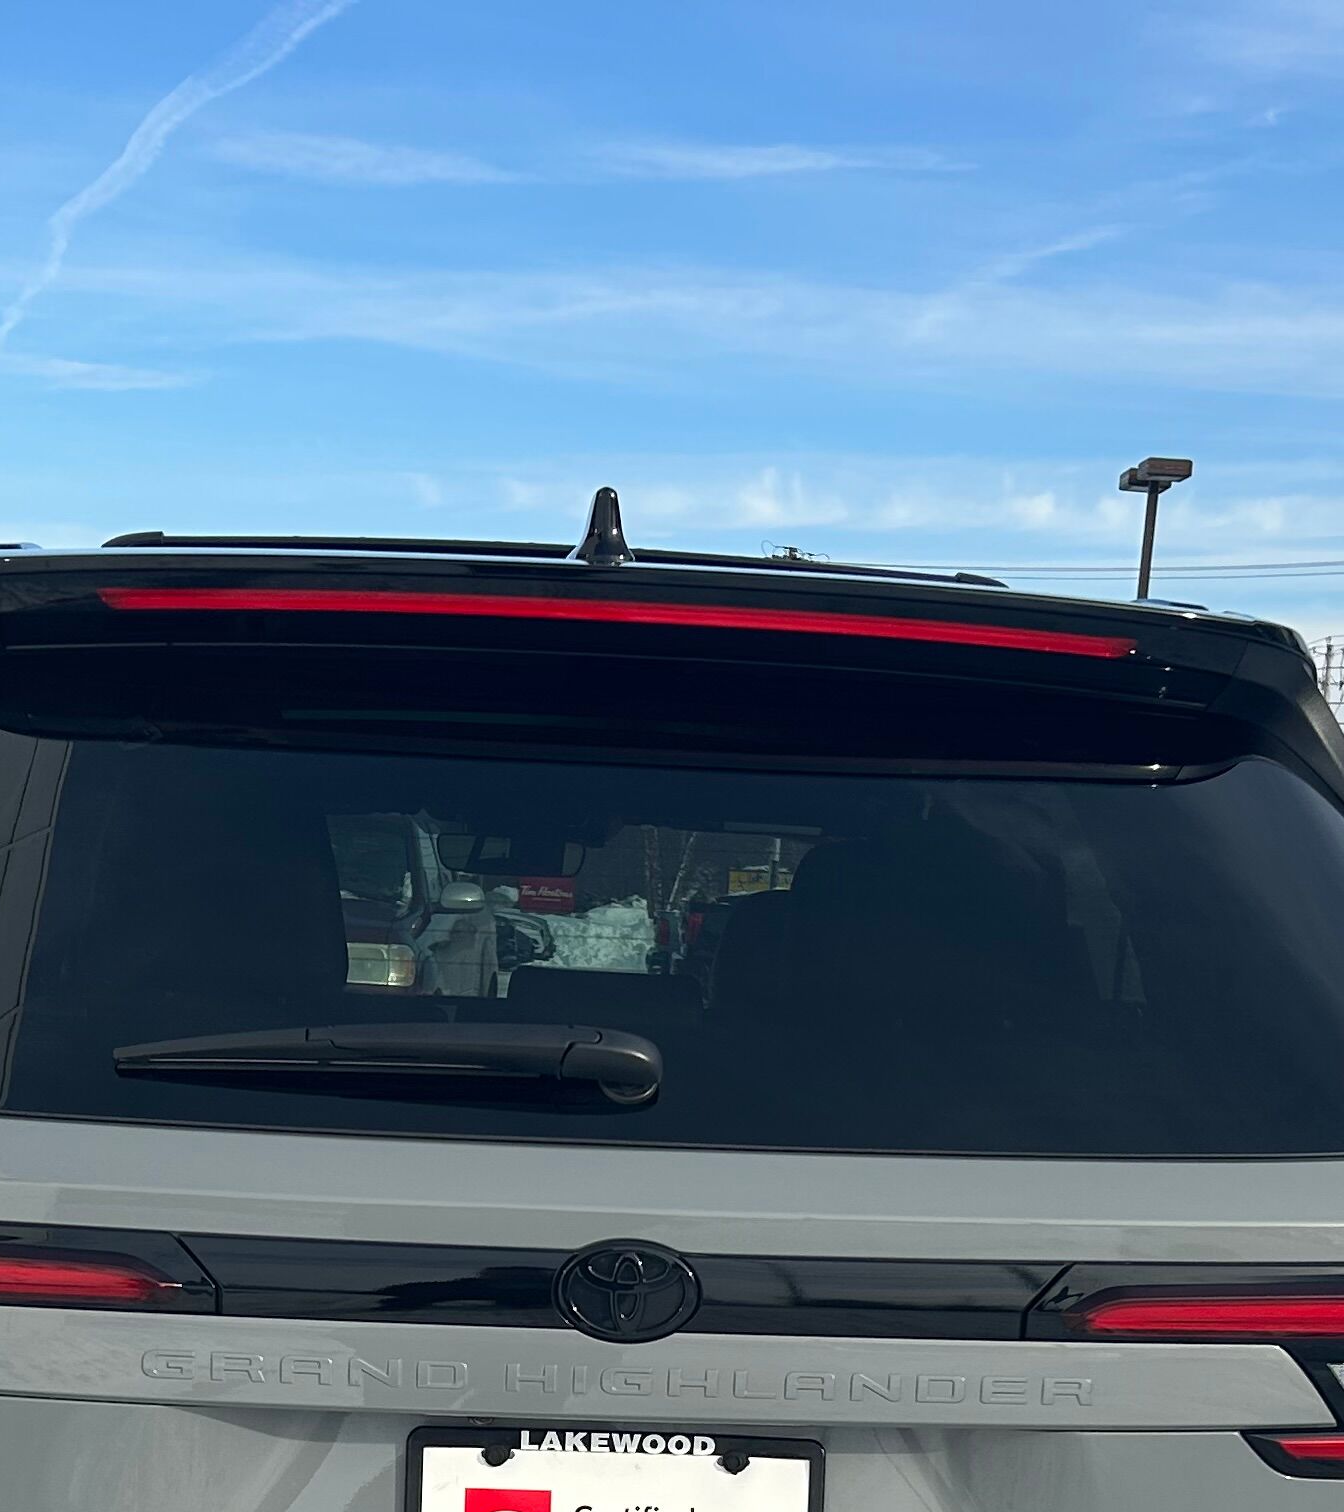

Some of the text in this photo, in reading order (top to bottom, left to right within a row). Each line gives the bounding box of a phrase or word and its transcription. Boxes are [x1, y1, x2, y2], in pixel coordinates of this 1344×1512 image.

[141, 1350, 1093, 1407] GRAND HIGHLANDER
[520, 1430, 716, 1457] LAKEWOOD
